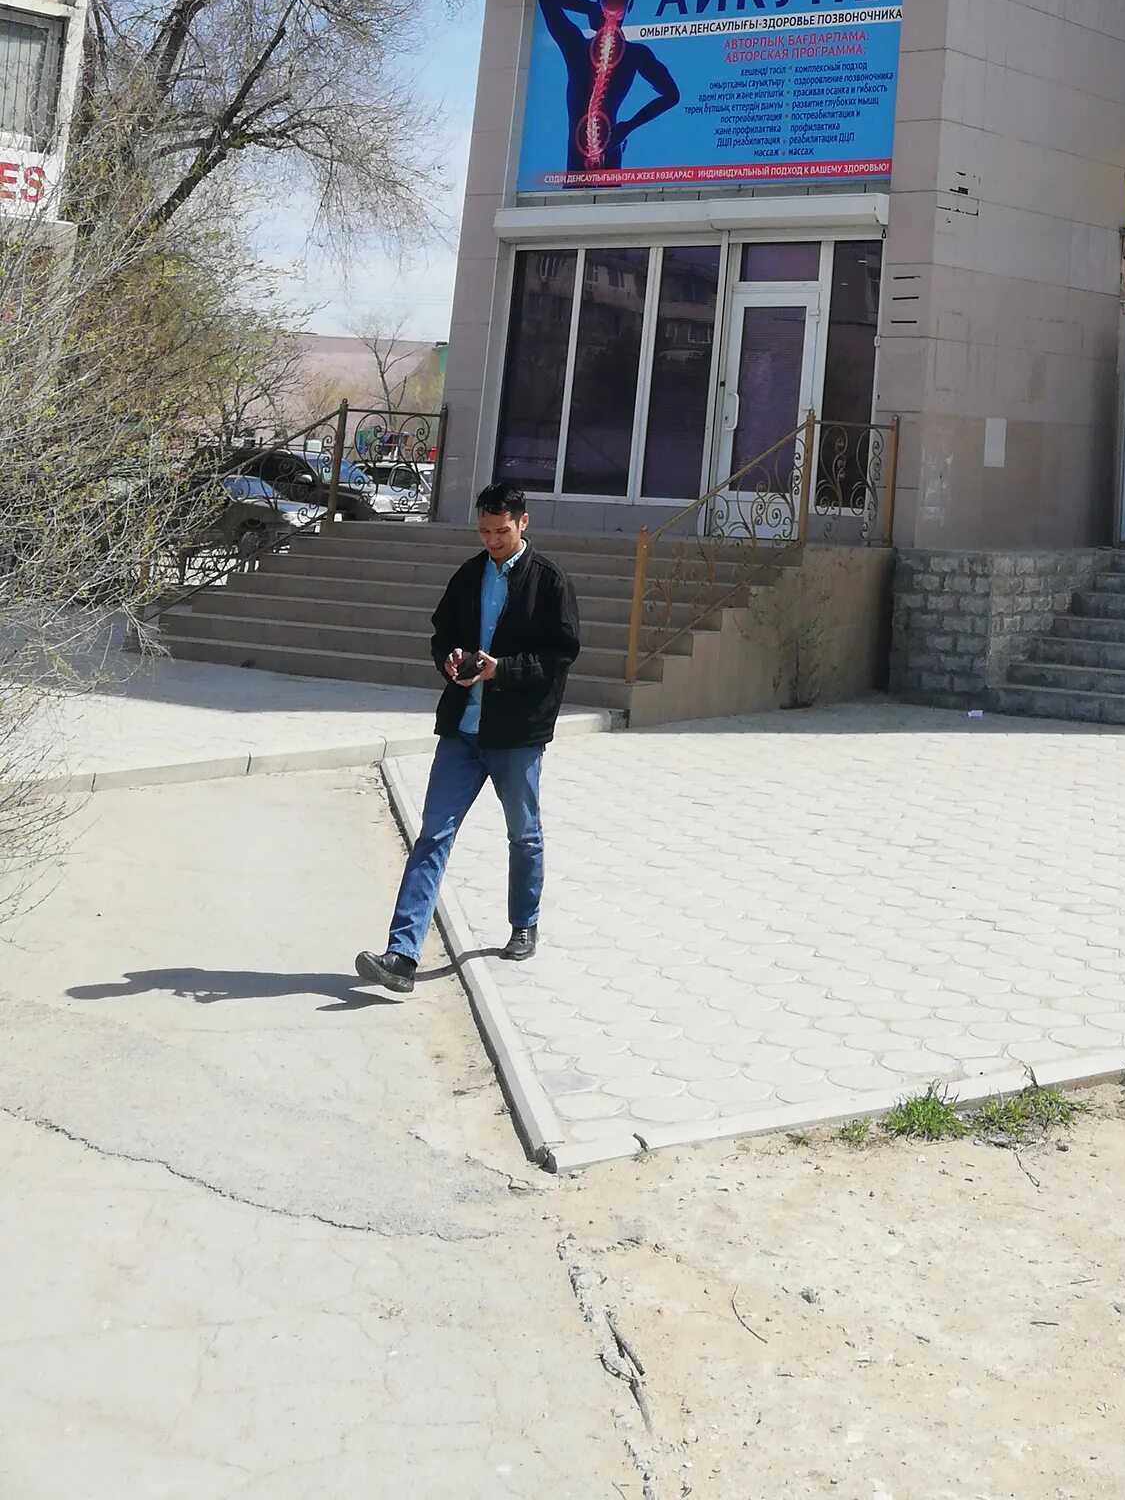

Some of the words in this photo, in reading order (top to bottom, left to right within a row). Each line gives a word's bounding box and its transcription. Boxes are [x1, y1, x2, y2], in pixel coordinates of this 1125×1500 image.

[640, 25, 688, 38] ОМЫРТҚА
[817, 8, 902, 25] ПОЗВОНОЧНИКА
[724, 35, 784, 50] АВТОРЛЫҚ
[724, 49, 788, 63] АВТОРСКАЯ
[795, 61, 840, 73] комплексный
[842, 61, 868, 71] подход
[794, 75, 842, 86] оздоровление
[844, 72, 894, 83] позвоночника
[793, 88, 824, 99] красивая
[825, 87, 850, 95] осанка
[856, 83, 888, 94] гибкость
[792, 100, 824, 110] развитие
[825, 97, 856, 108] глубоких
[858, 97, 879, 106] мышц
[720, 112, 782, 124] постреабилитация
[791, 109, 855, 121] постреабилитация
[732, 125, 781, 137] профилактика
[790, 122, 840, 134] профилактика
[717, 138, 732, 148] ДЦП
[733, 136, 780, 147] реабилитация
[789, 134, 838, 145] реабилитация
[838, 132, 855, 143] ДЦП
[754, 149, 779, 157] массаж
[788, 147, 814, 156] массаж
[636, 172, 655, 181] ЖЕКЕ
[698, 165, 770, 179] ИНДИВИДУАЛЬНЫЙ
[771, 165, 803, 176] ПОДХОД
[804, 166, 809, 174] К
[810, 165, 842, 174] ВАШЕМУ
[843, 163, 890, 173] ЗДОРОВЬЮ!
